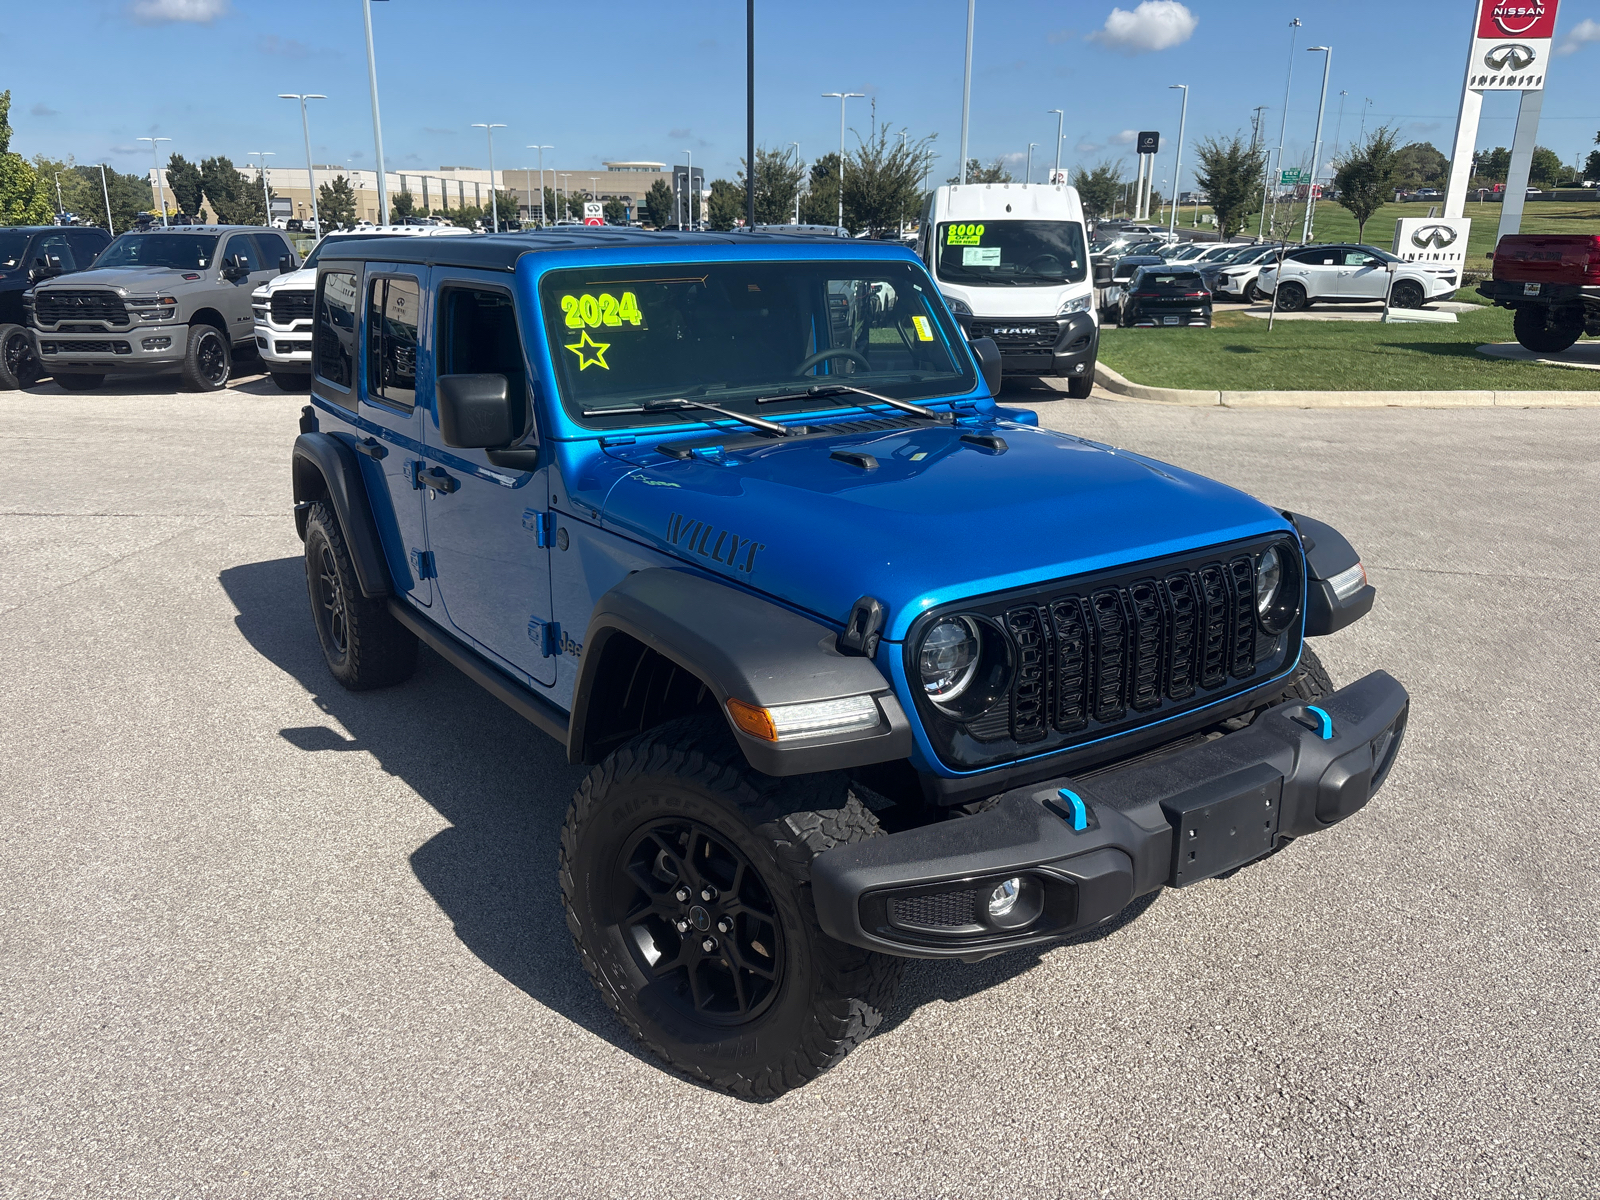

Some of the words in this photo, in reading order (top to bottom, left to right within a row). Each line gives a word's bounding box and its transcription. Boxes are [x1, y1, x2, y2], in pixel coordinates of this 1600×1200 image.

[1493, 7, 1545, 15] NISSAN
[1470, 75, 1543, 87] INFINITI
[948, 224, 985, 236] 8000
[561, 292, 643, 328] 2024
[666, 511, 766, 574] WILLYS
